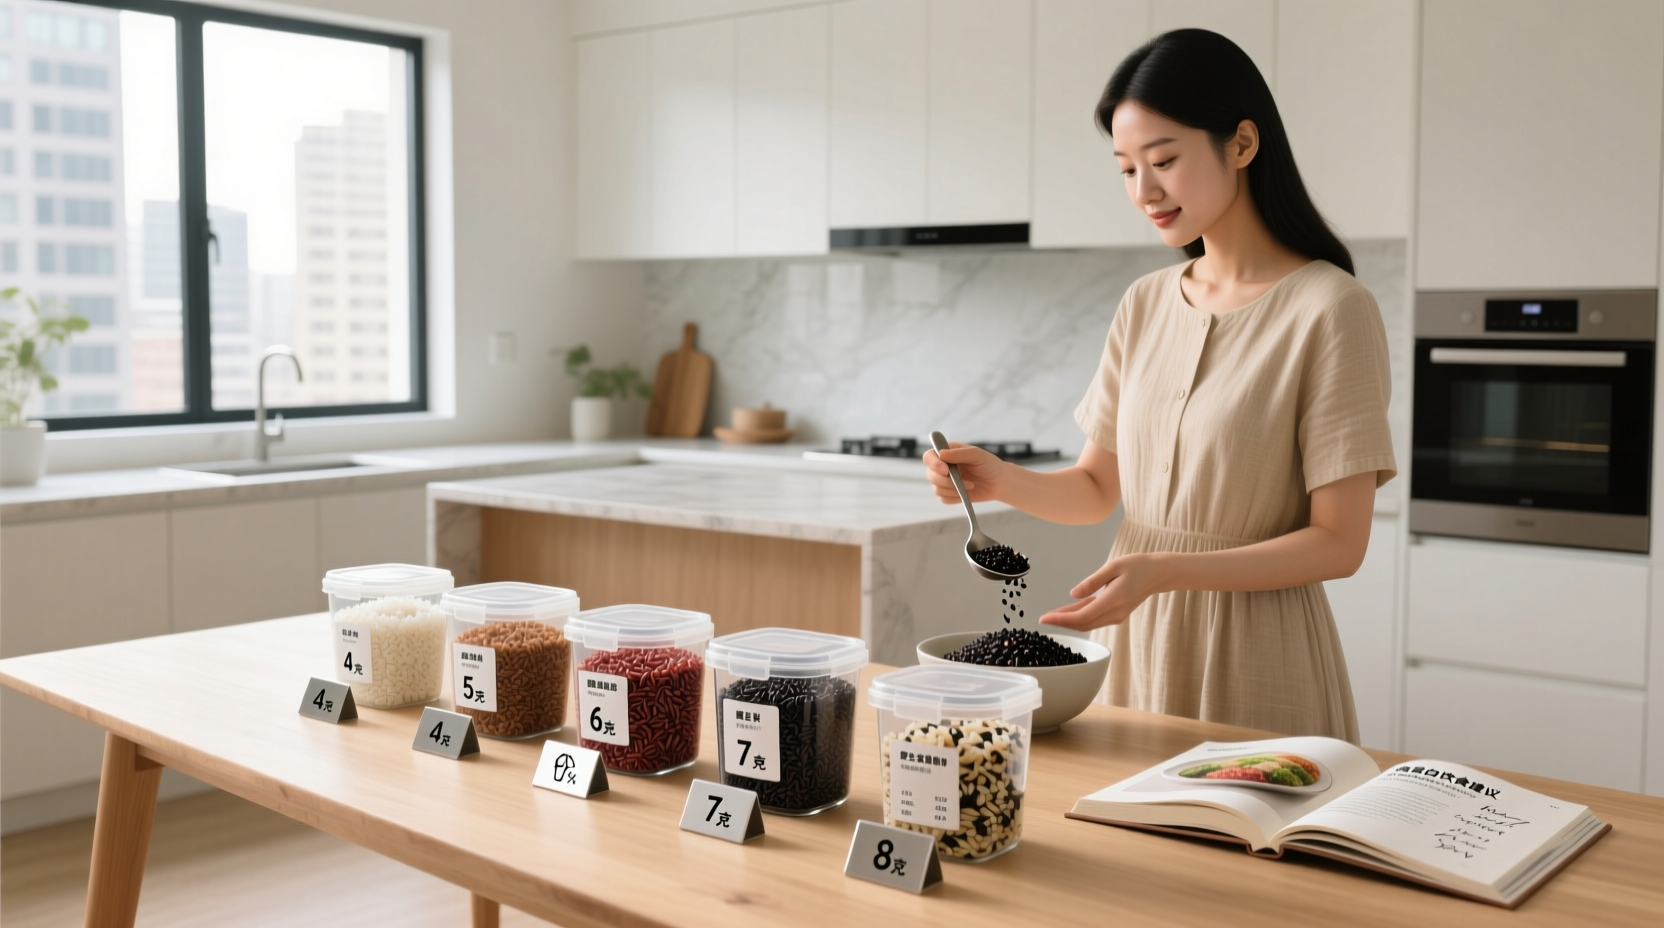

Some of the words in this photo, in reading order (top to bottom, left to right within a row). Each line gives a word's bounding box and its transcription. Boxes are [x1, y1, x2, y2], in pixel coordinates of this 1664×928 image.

[590, 706, 616, 736] 6克
[737, 739, 766, 771] 7克
[705, 794, 732, 828] 7克
[873, 839, 907, 876] 8克
